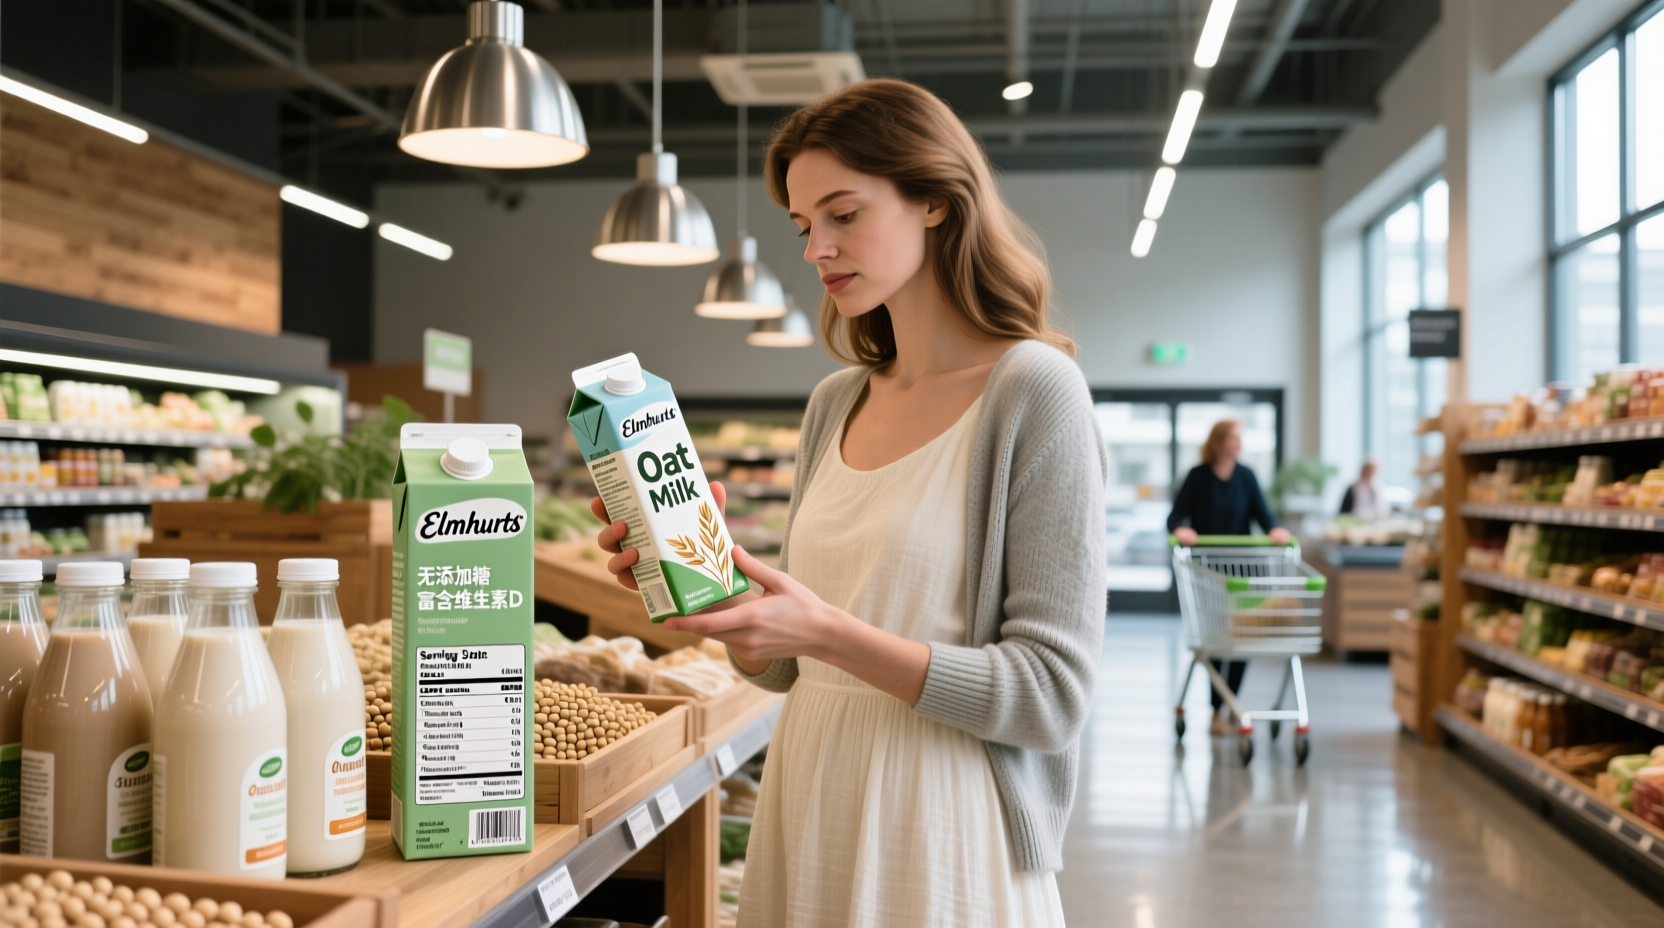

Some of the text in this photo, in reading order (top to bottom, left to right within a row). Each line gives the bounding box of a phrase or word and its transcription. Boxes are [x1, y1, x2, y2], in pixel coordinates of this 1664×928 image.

[637, 442, 695, 483] Oat
[648, 476, 701, 513] Milk
[419, 510, 522, 540] Elmhurts
[417, 565, 491, 586] 无添加糖
[417, 589, 523, 611] 富含维生素D
